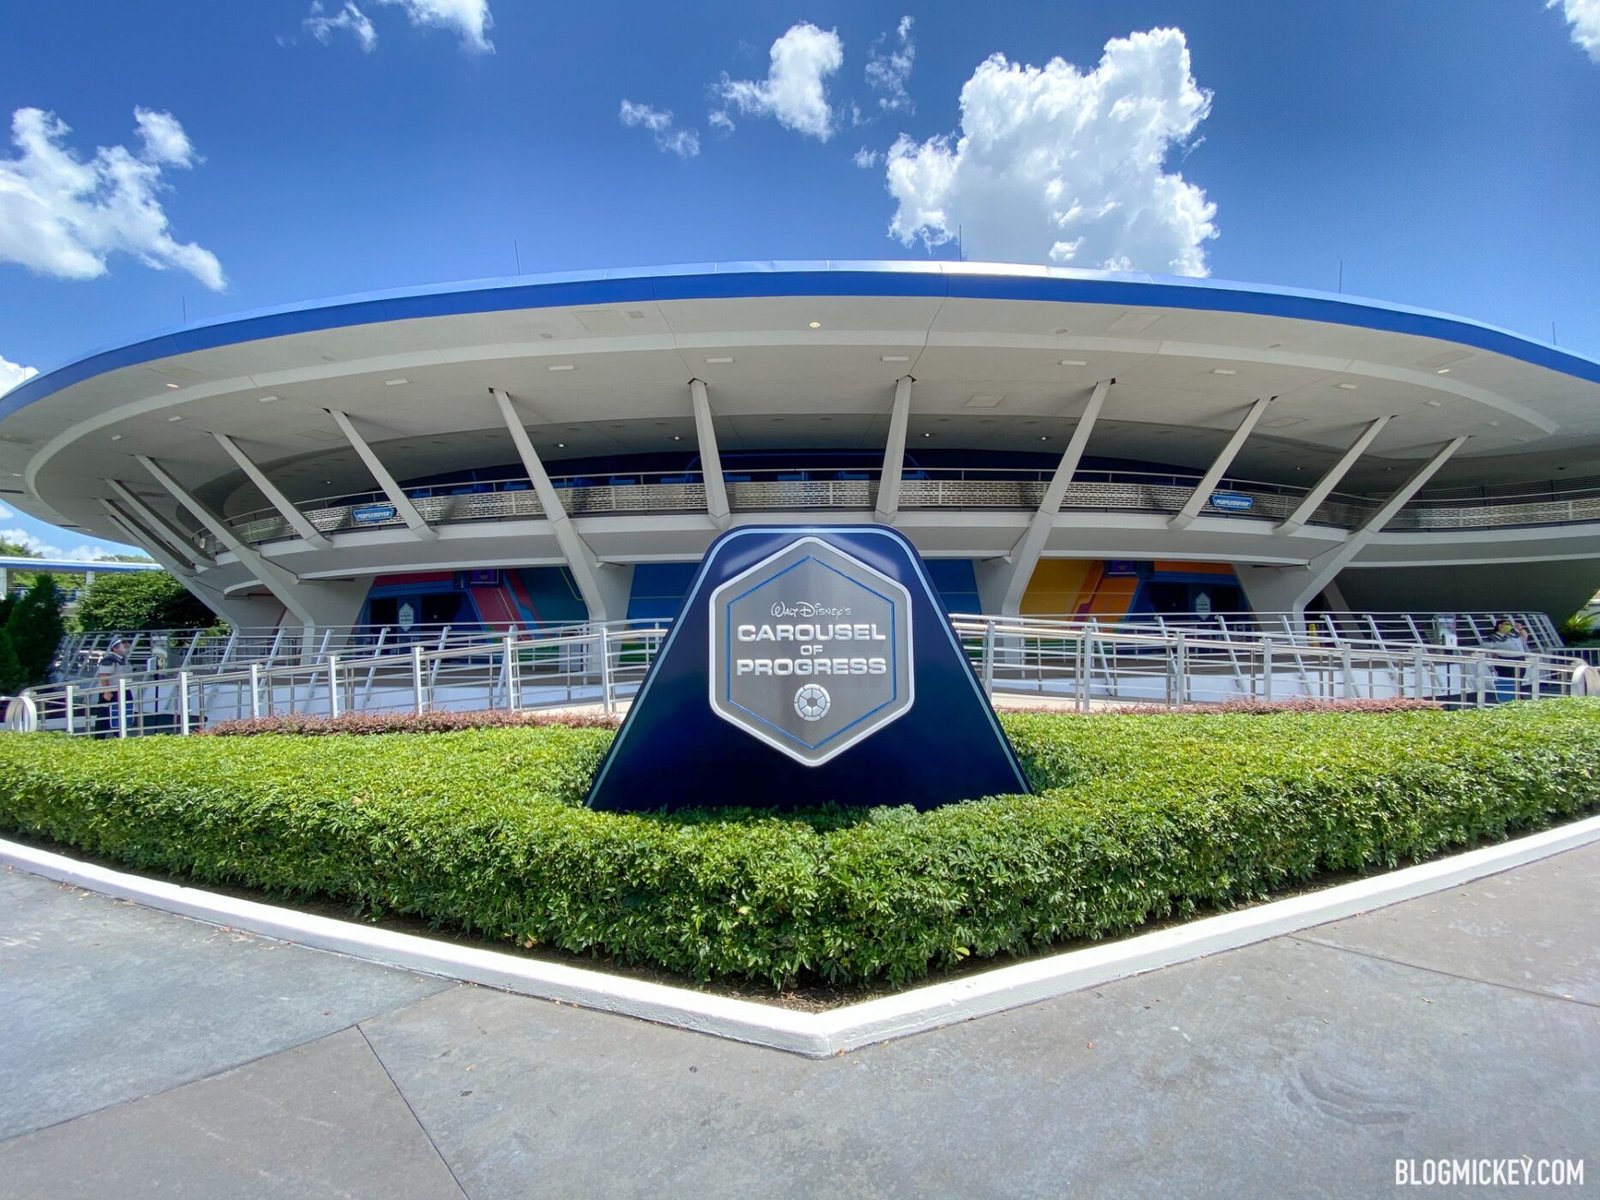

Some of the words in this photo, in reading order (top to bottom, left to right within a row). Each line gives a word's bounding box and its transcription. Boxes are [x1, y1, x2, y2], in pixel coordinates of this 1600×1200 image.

[737, 624, 886, 642] CAROUSEL
[800, 645, 823, 656] OF
[736, 658, 887, 676] PROGRESS
